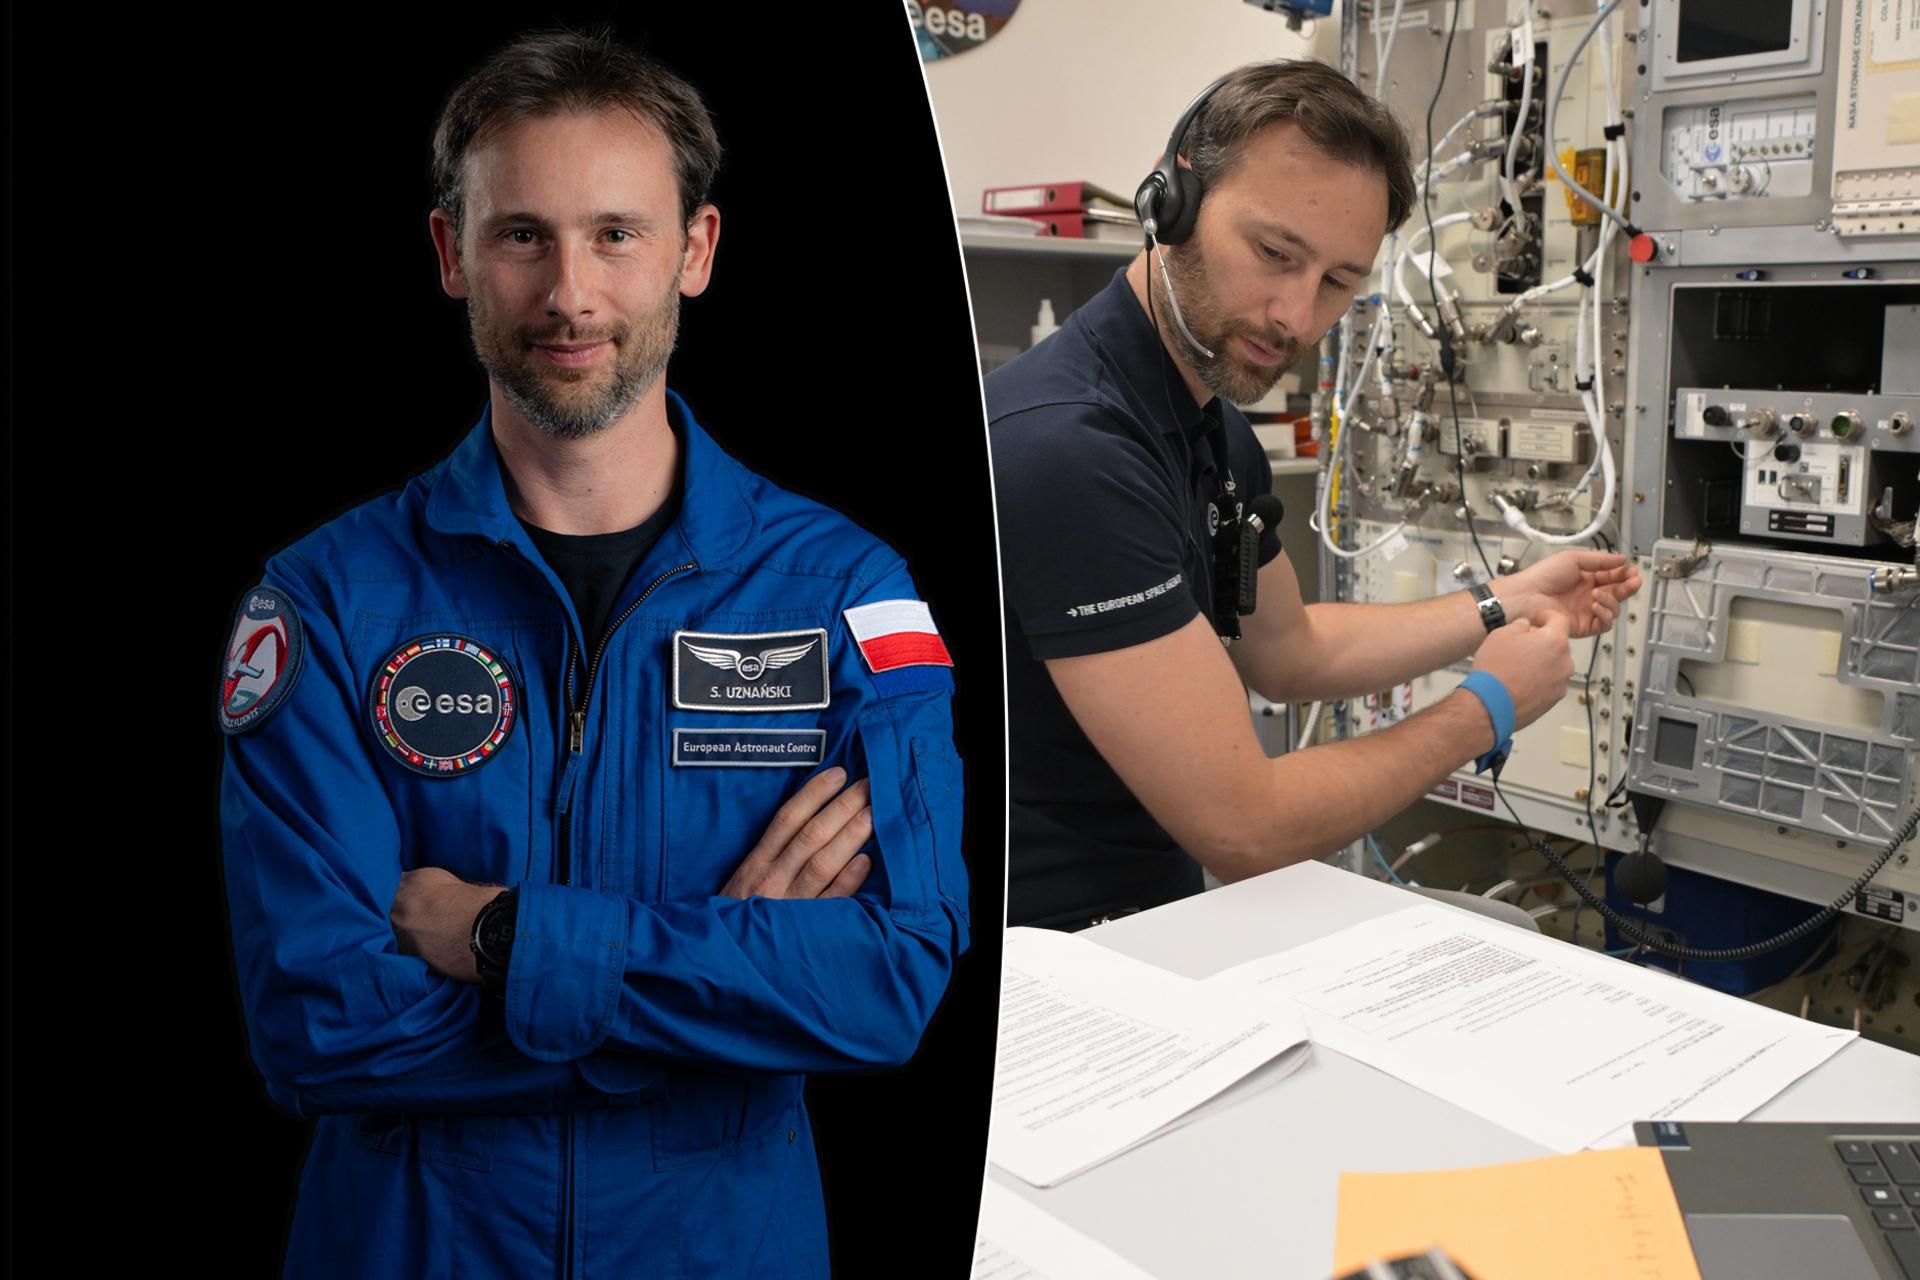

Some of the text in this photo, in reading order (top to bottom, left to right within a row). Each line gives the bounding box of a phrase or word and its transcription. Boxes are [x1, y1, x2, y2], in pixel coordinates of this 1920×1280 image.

[925, 6, 987, 41] esa
[1850, 47, 1860, 99] STOWAGE
[1708, 107, 1720, 140] esa
[1849, 102, 1857, 129] NASA
[258, 599, 275, 610] esa
[1077, 604, 1097, 616] THE
[1097, 592, 1145, 612] EUROPEAN
[1144, 583, 1167, 600] SPACE
[742, 663, 759, 672] esa
[436, 692, 493, 715] esa
[710, 683, 792, 699] S. UZNAŃSKI
[683, 742, 817, 754] European Astronaut Centre
